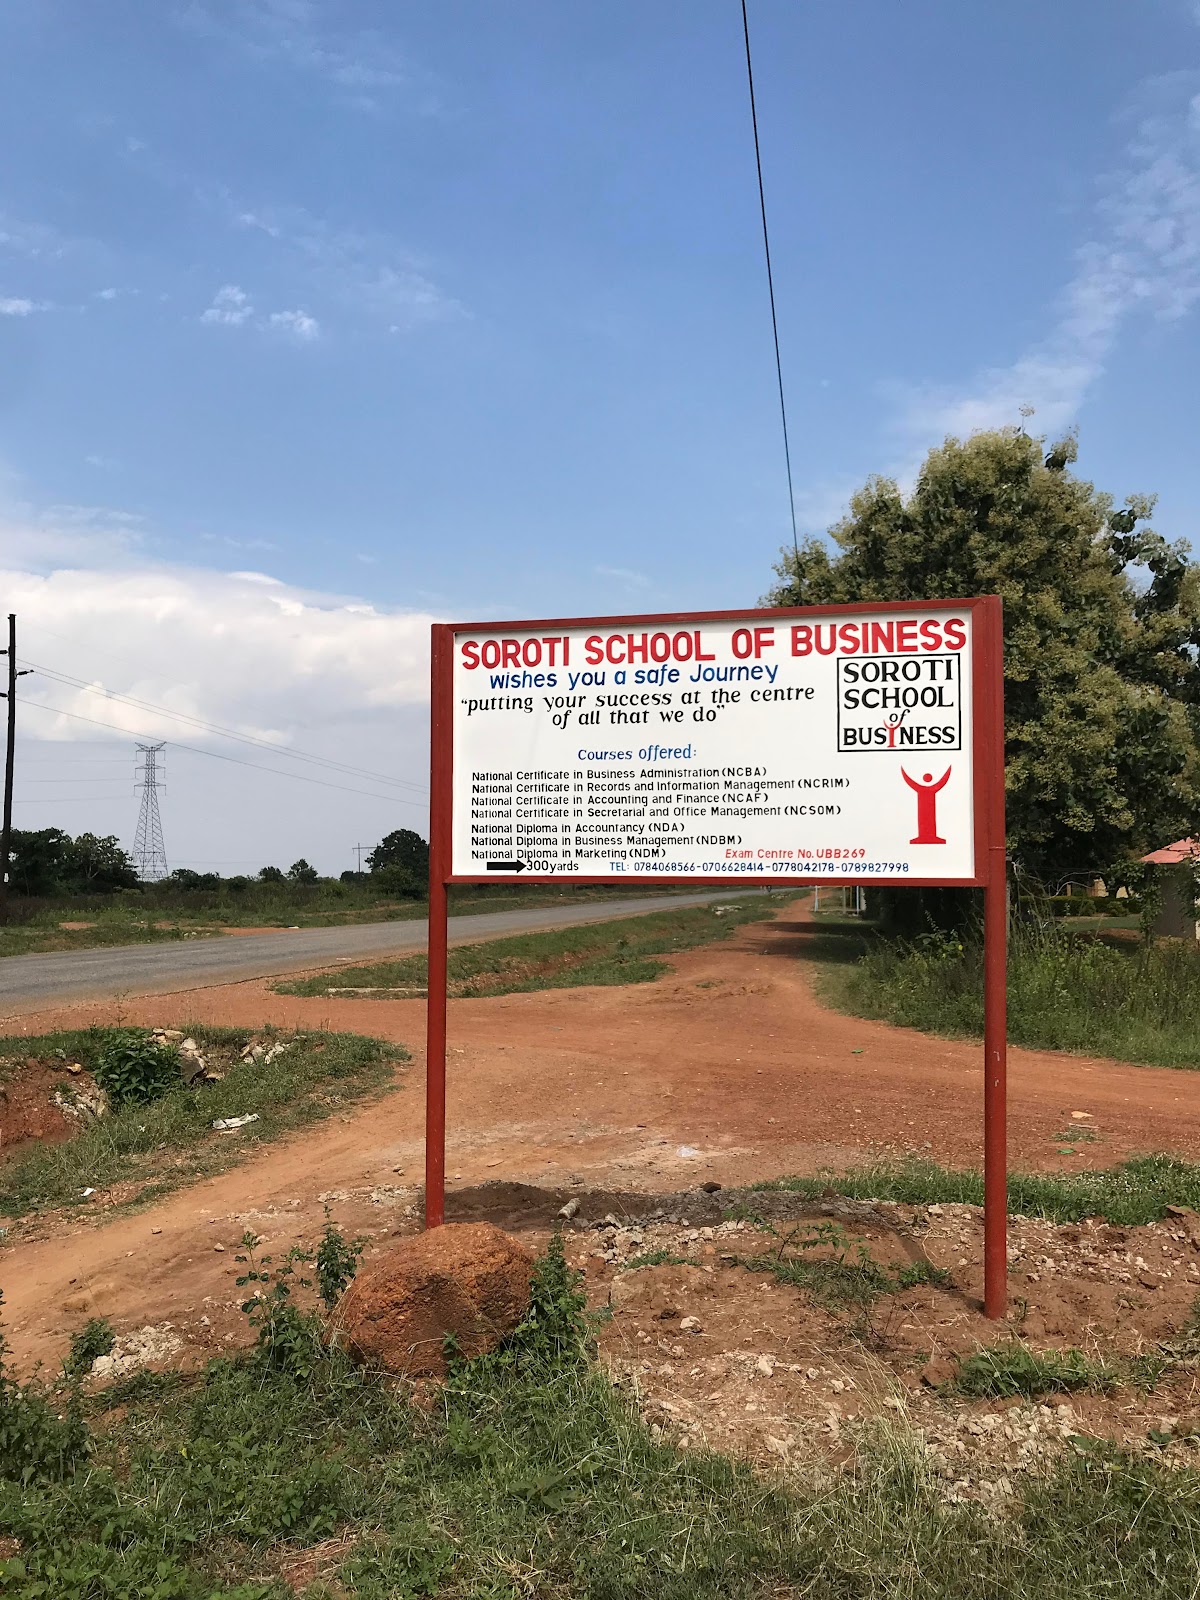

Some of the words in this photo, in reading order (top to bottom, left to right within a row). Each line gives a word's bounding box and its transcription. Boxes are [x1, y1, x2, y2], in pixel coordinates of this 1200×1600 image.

[462, 636, 570, 670] SOROTI
[585, 630, 715, 665] SCHOOL
[732, 627, 775, 659] OF
[791, 618, 966, 657] BUSINESS
[490, 670, 558, 689] wishes
[568, 670, 605, 690] you
[614, 670, 626, 685] a
[635, 665, 680, 686] safe
[690, 664, 778, 683] Journey
[843, 659, 953, 683] SOROTI
[543, 694, 586, 711] your
[595, 691, 672, 707] success
[681, 691, 701, 705] at
[712, 688, 741, 704] the
[751, 686, 815, 702] centre
[843, 686, 954, 709] SCHOOL
[552, 710, 572, 729] of
[579, 710, 600, 725] all
[610, 709, 649, 724] that
[660, 710, 684, 723] we
[889, 709, 910, 723] of
[578, 749, 632, 761] Courses
[639, 744, 697, 762] offered:
[472, 772, 512, 781] National
[516, 770, 569, 780] Certificate
[573, 771, 583, 779] in
[587, 770, 635, 779] Business
[639, 768, 719, 778] Administration
[472, 784, 512, 793] National
[516, 783, 569, 792] Certificate
[573, 783, 583, 792] in
[588, 782, 630, 792] Records
[634, 782, 653, 791] and
[657, 781, 719, 791] Information
[724, 780, 794, 792] Management
[472, 796, 512, 806] National
[516, 796, 569, 805] Certificate
[573, 796, 582, 804] in
[587, 795, 647, 806] Accounting
[652, 794, 672, 803] and
[678, 794, 719, 803] Finance
[472, 809, 512, 818] National
[516, 808, 569, 817] Certificate
[573, 808, 582, 817] in
[587, 806, 645, 817] Secretarial
[649, 806, 669, 817] and
[673, 806, 706, 817] Office
[711, 807, 781, 818] Management
[472, 824, 512, 834] National
[516, 824, 558, 834] Diploma
[561, 824, 571, 832] in
[575, 822, 645, 834] Accountancy
[472, 836, 512, 846] National
[516, 836, 558, 847] Diploma
[561, 836, 571, 845] in
[575, 836, 622, 845] Business
[626, 835, 694, 847] Management
[472, 849, 512, 859] National
[516, 849, 558, 861] Diploma
[561, 849, 571, 858] in
[575, 848, 626, 859] Marketing
[725, 849, 753, 859] Exam
[757, 849, 793, 859] Centre
[610, 862, 630, 872] TEL:
